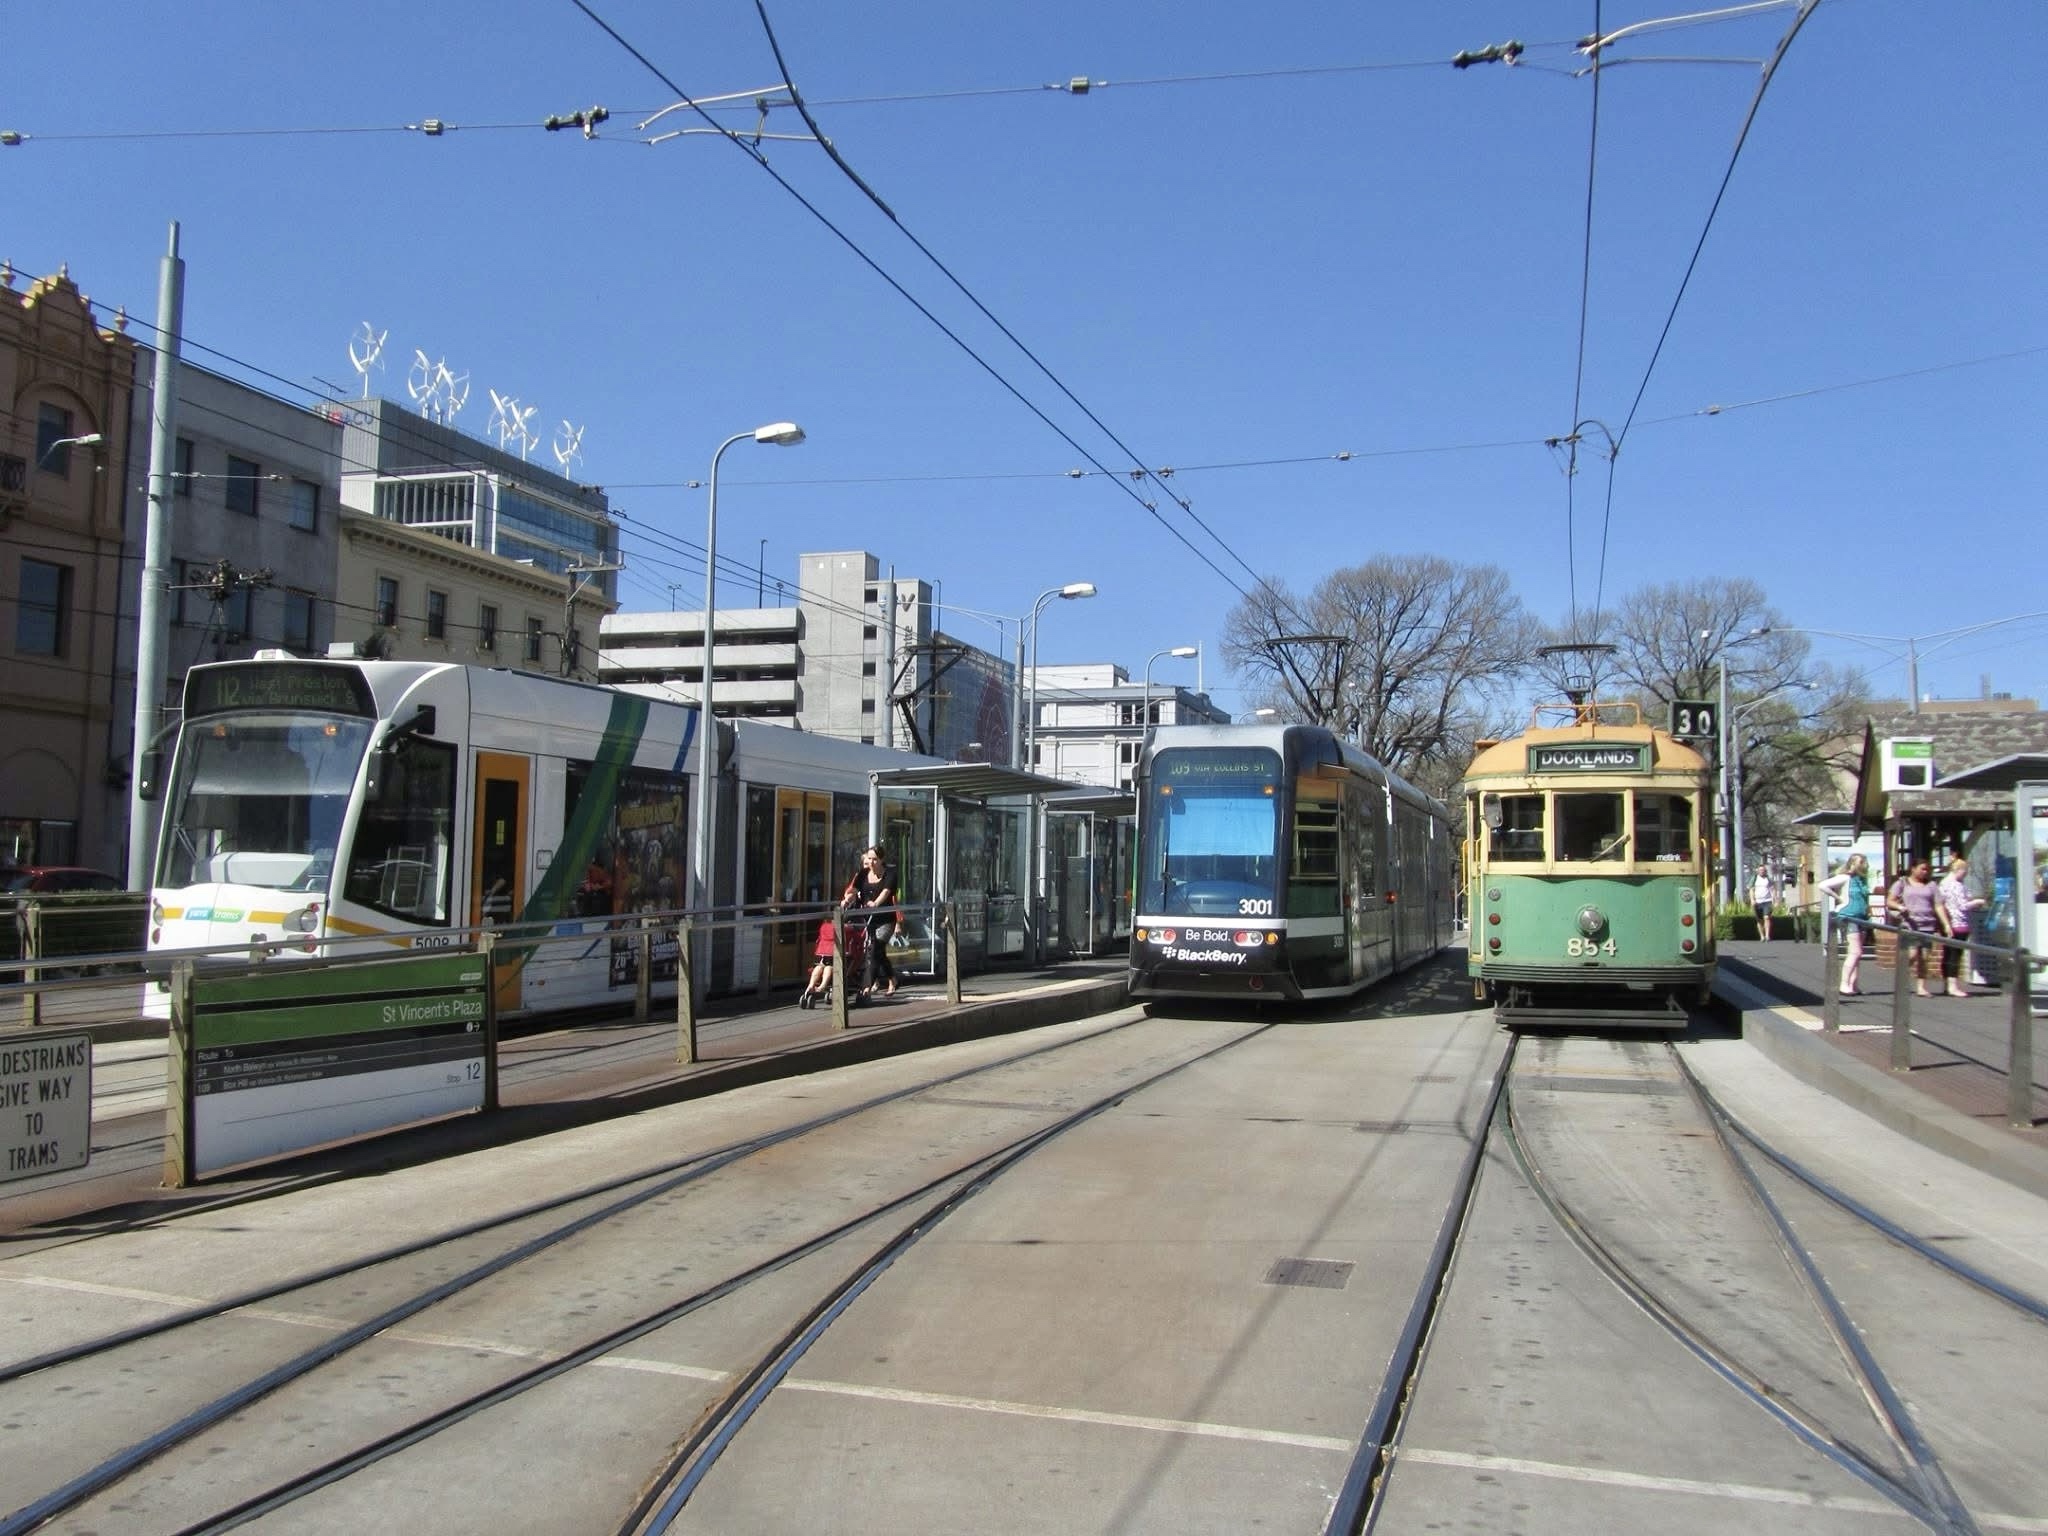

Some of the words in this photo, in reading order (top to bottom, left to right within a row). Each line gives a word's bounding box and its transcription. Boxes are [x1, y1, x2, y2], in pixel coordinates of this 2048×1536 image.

[1678, 709, 1711, 734] 30
[1541, 750, 1635, 765] DOCKLANDS
[1239, 898, 1273, 915] 3001
[1185, 929, 1200, 940] Be
[1203, 929, 1231, 942] Bold.
[1568, 937, 1617, 956] 854
[383, 1005, 396, 1023] St
[399, 1001, 450, 1021] Vincent's
[453, 999, 482, 1017] Plaza
[0, 1043, 85, 1076] DESTRIANS
[466, 1062, 481, 1080] 12
[39, 1076, 72, 1102] WAY
[25, 1112, 43, 1136] TO
[8, 1141, 59, 1171] TRAMS
